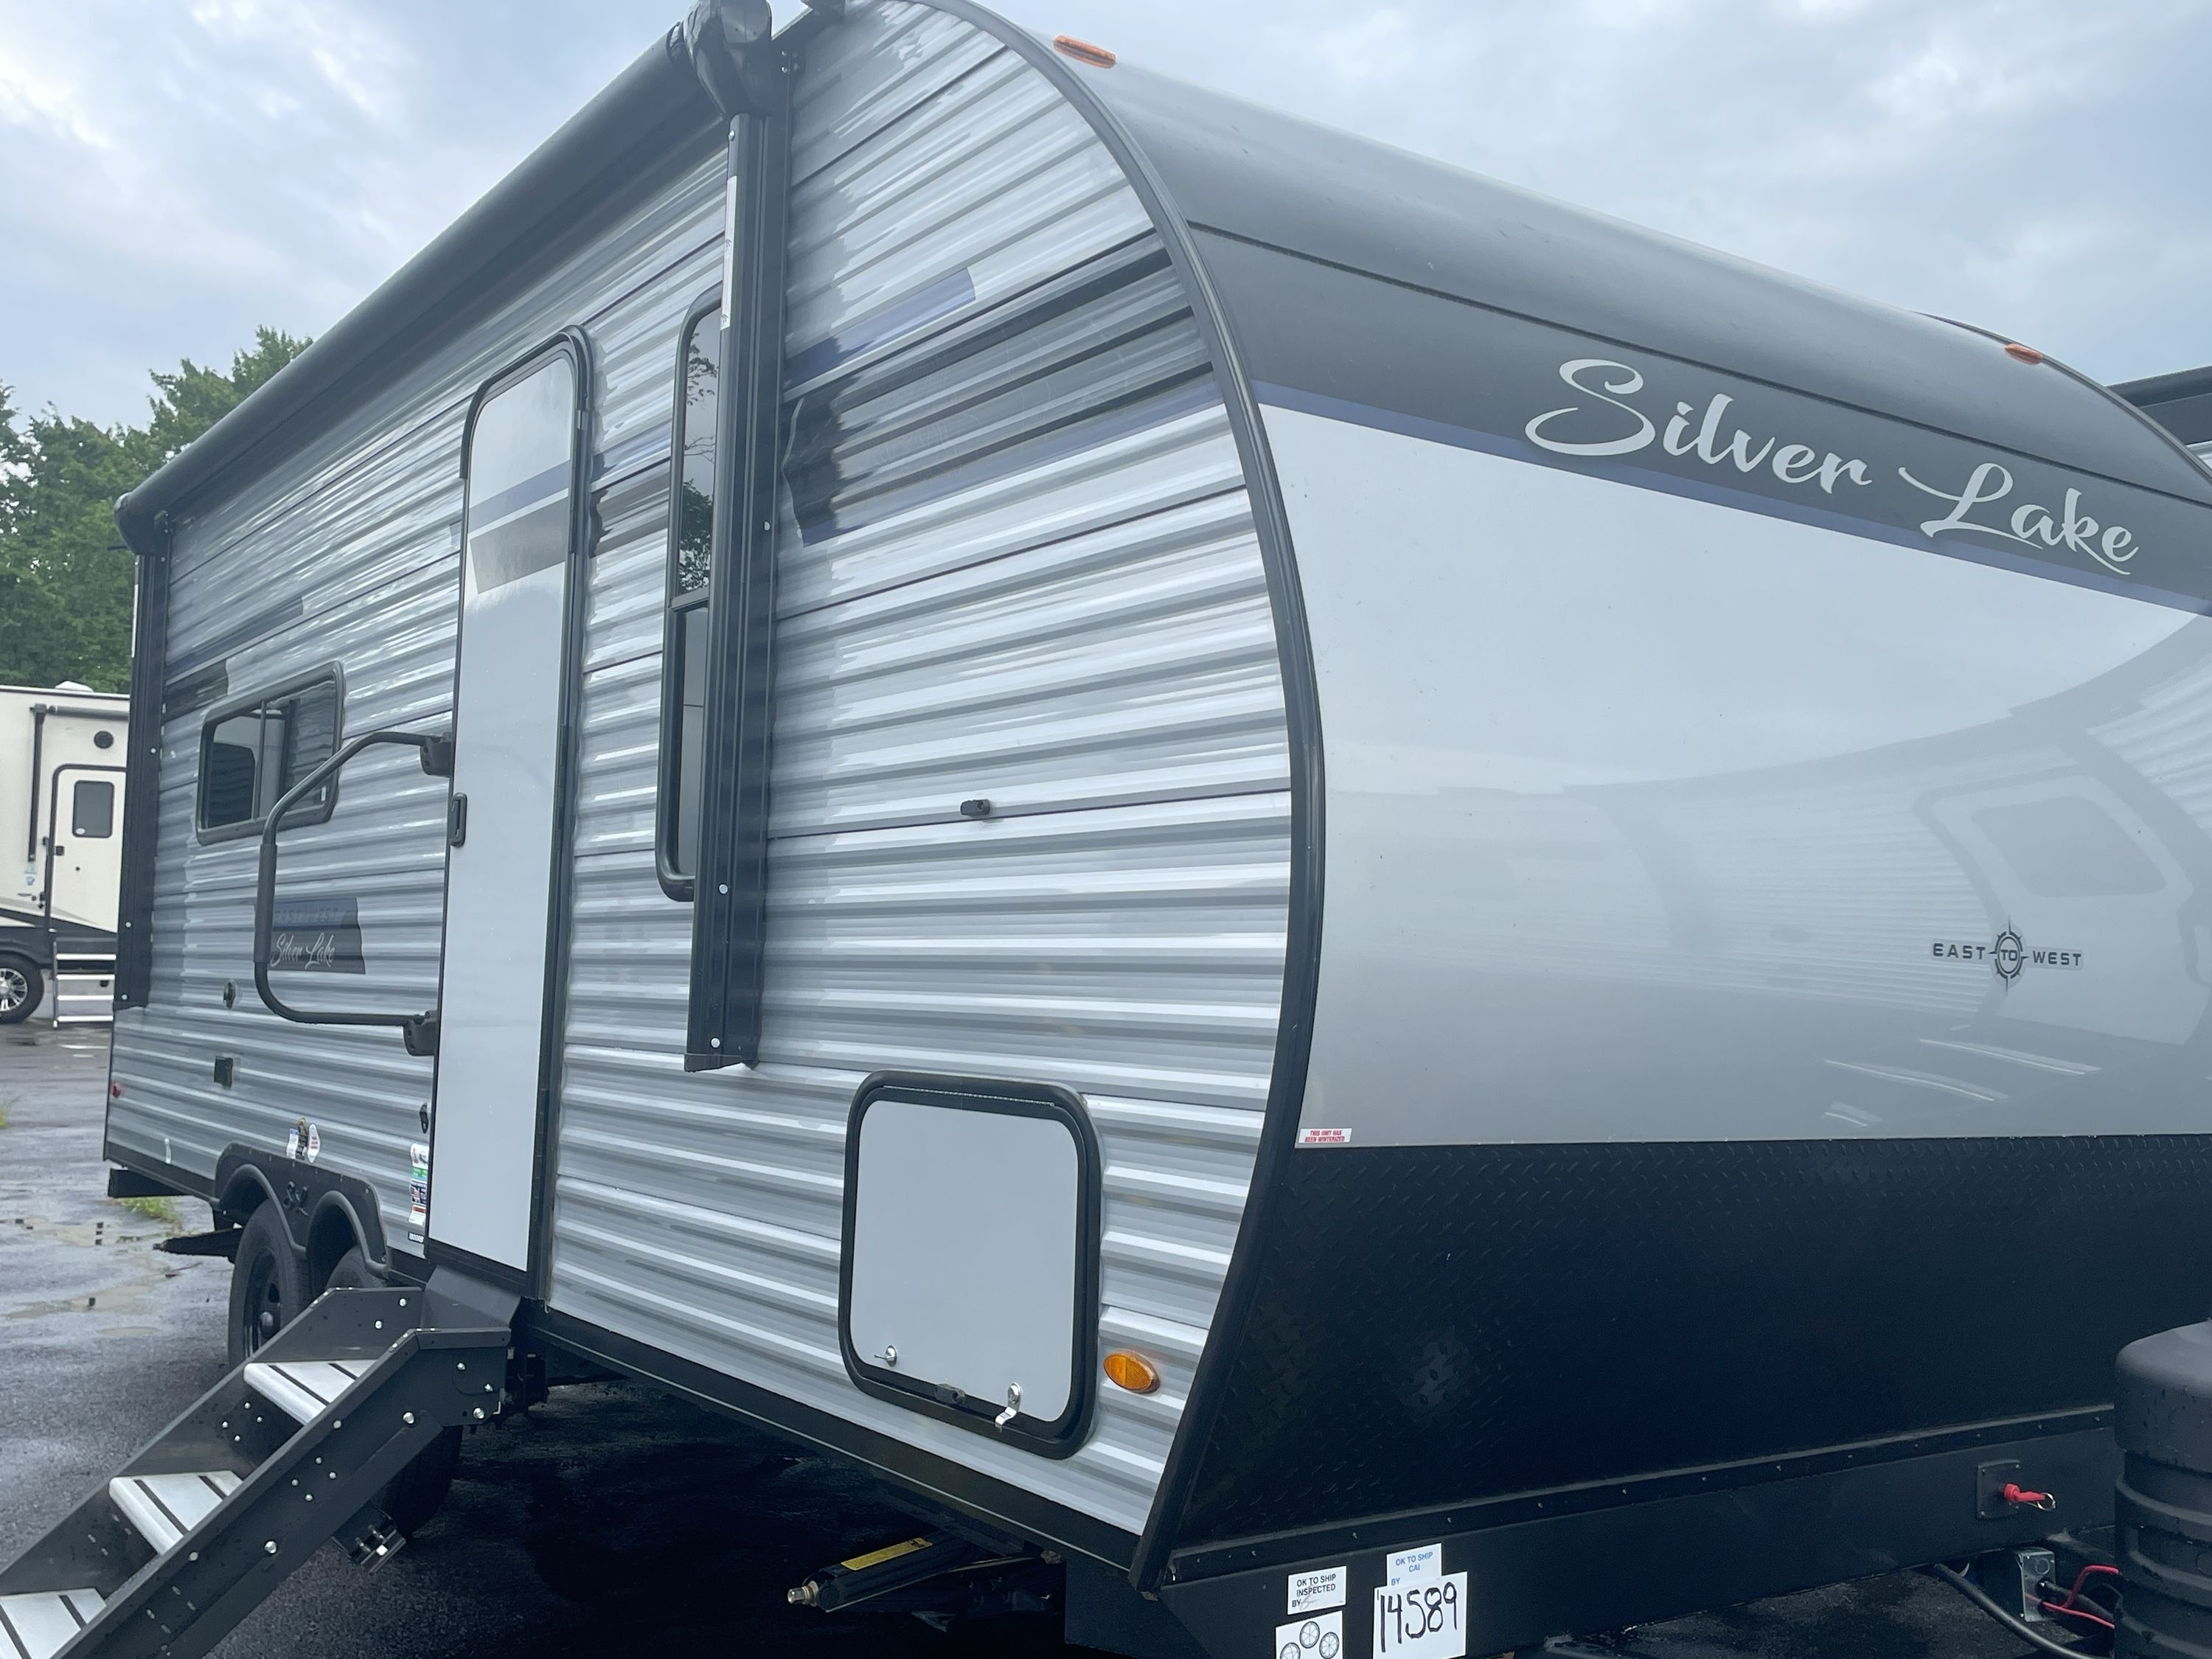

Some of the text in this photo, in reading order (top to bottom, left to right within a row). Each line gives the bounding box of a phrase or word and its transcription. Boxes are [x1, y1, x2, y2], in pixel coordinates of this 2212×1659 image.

[1524, 358, 2140, 576] Silver Lake
[270, 932, 335, 970] Silver Lake
[1933, 943, 2082, 966] EAST TO WEST
[1396, 1551, 1433, 1566] OK TO SHIP
[1408, 1564, 1420, 1573] CAI
[1296, 1573, 1336, 1587] OK TO SHIP
[1391, 1577, 1400, 1586] BY
[1296, 1583, 1336, 1597] INSPECTED
[1292, 1599, 1301, 1608] BY
[1380, 1582, 1457, 1653] 14589
